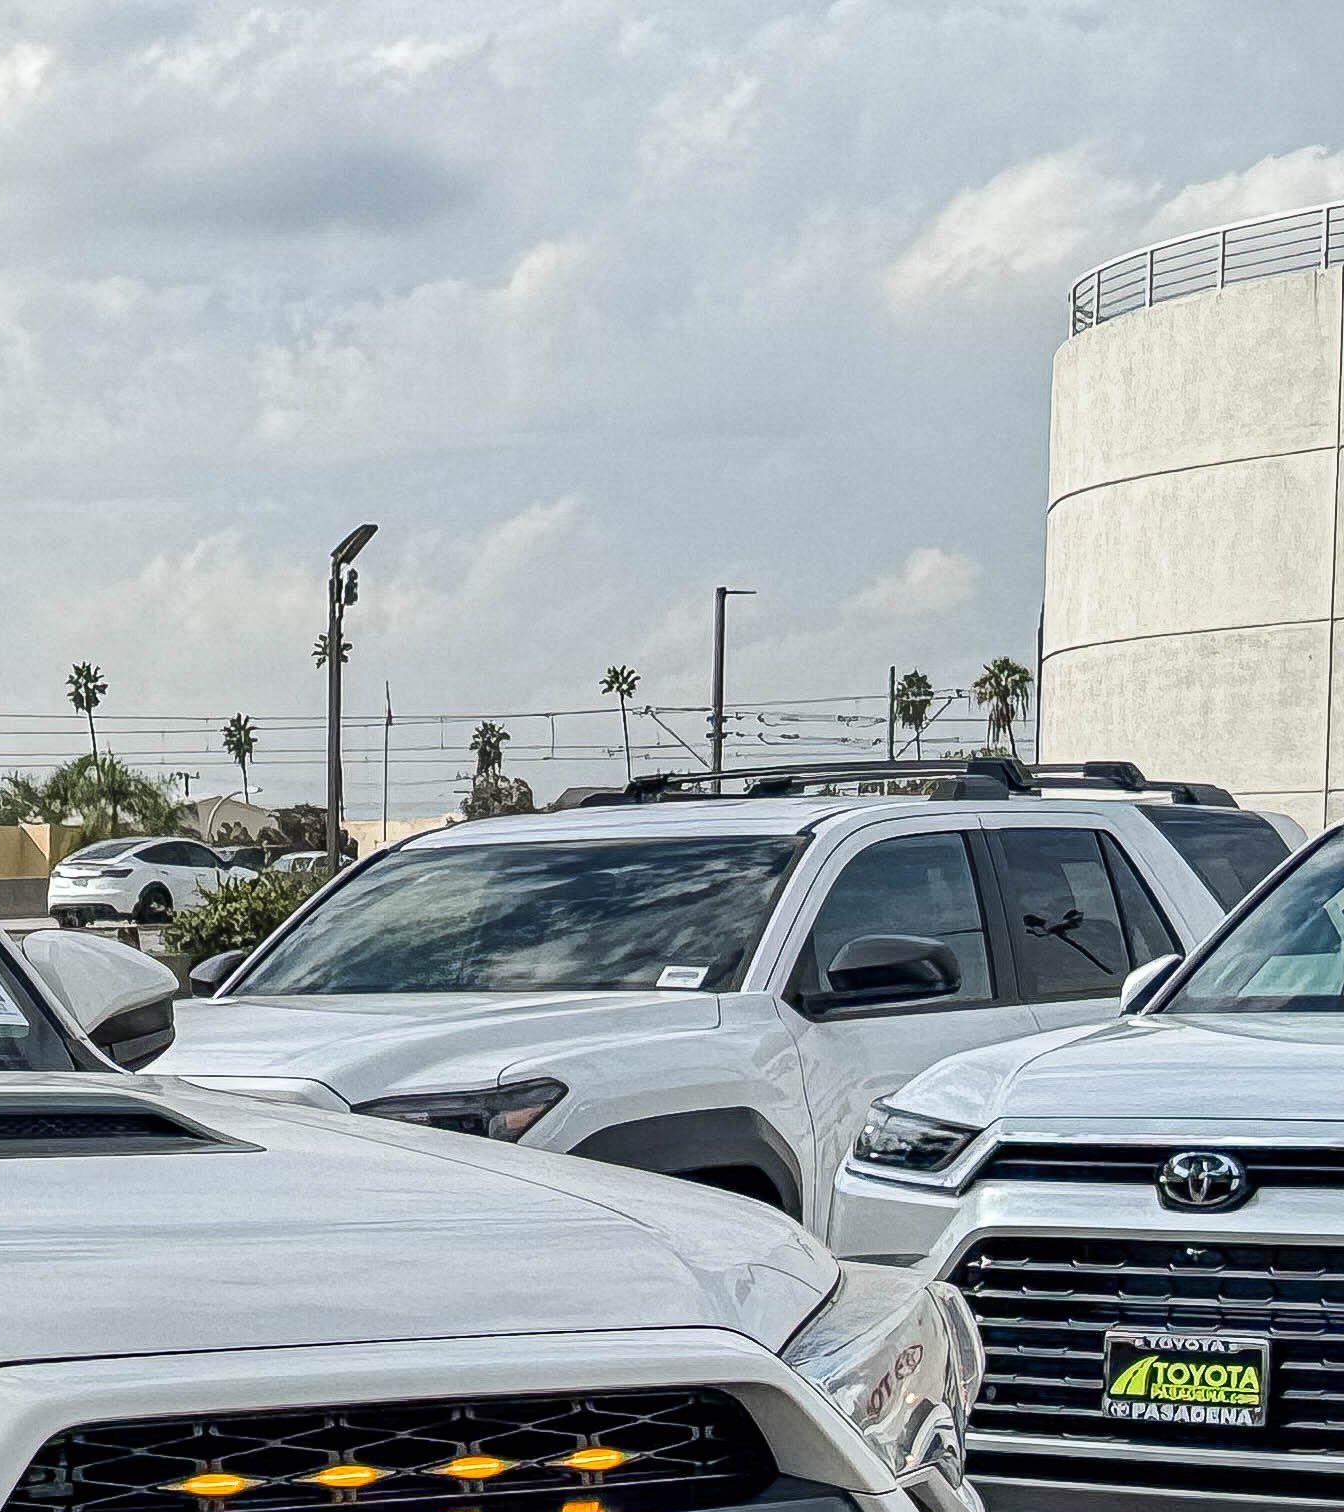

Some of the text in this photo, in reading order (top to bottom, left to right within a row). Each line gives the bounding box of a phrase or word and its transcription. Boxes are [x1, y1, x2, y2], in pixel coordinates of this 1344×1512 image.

[1146, 1337, 1226, 1352] TOYOTA
[1152, 1362, 1259, 1391] TOYOTA
[1132, 1403, 1253, 1424] PASADENA
